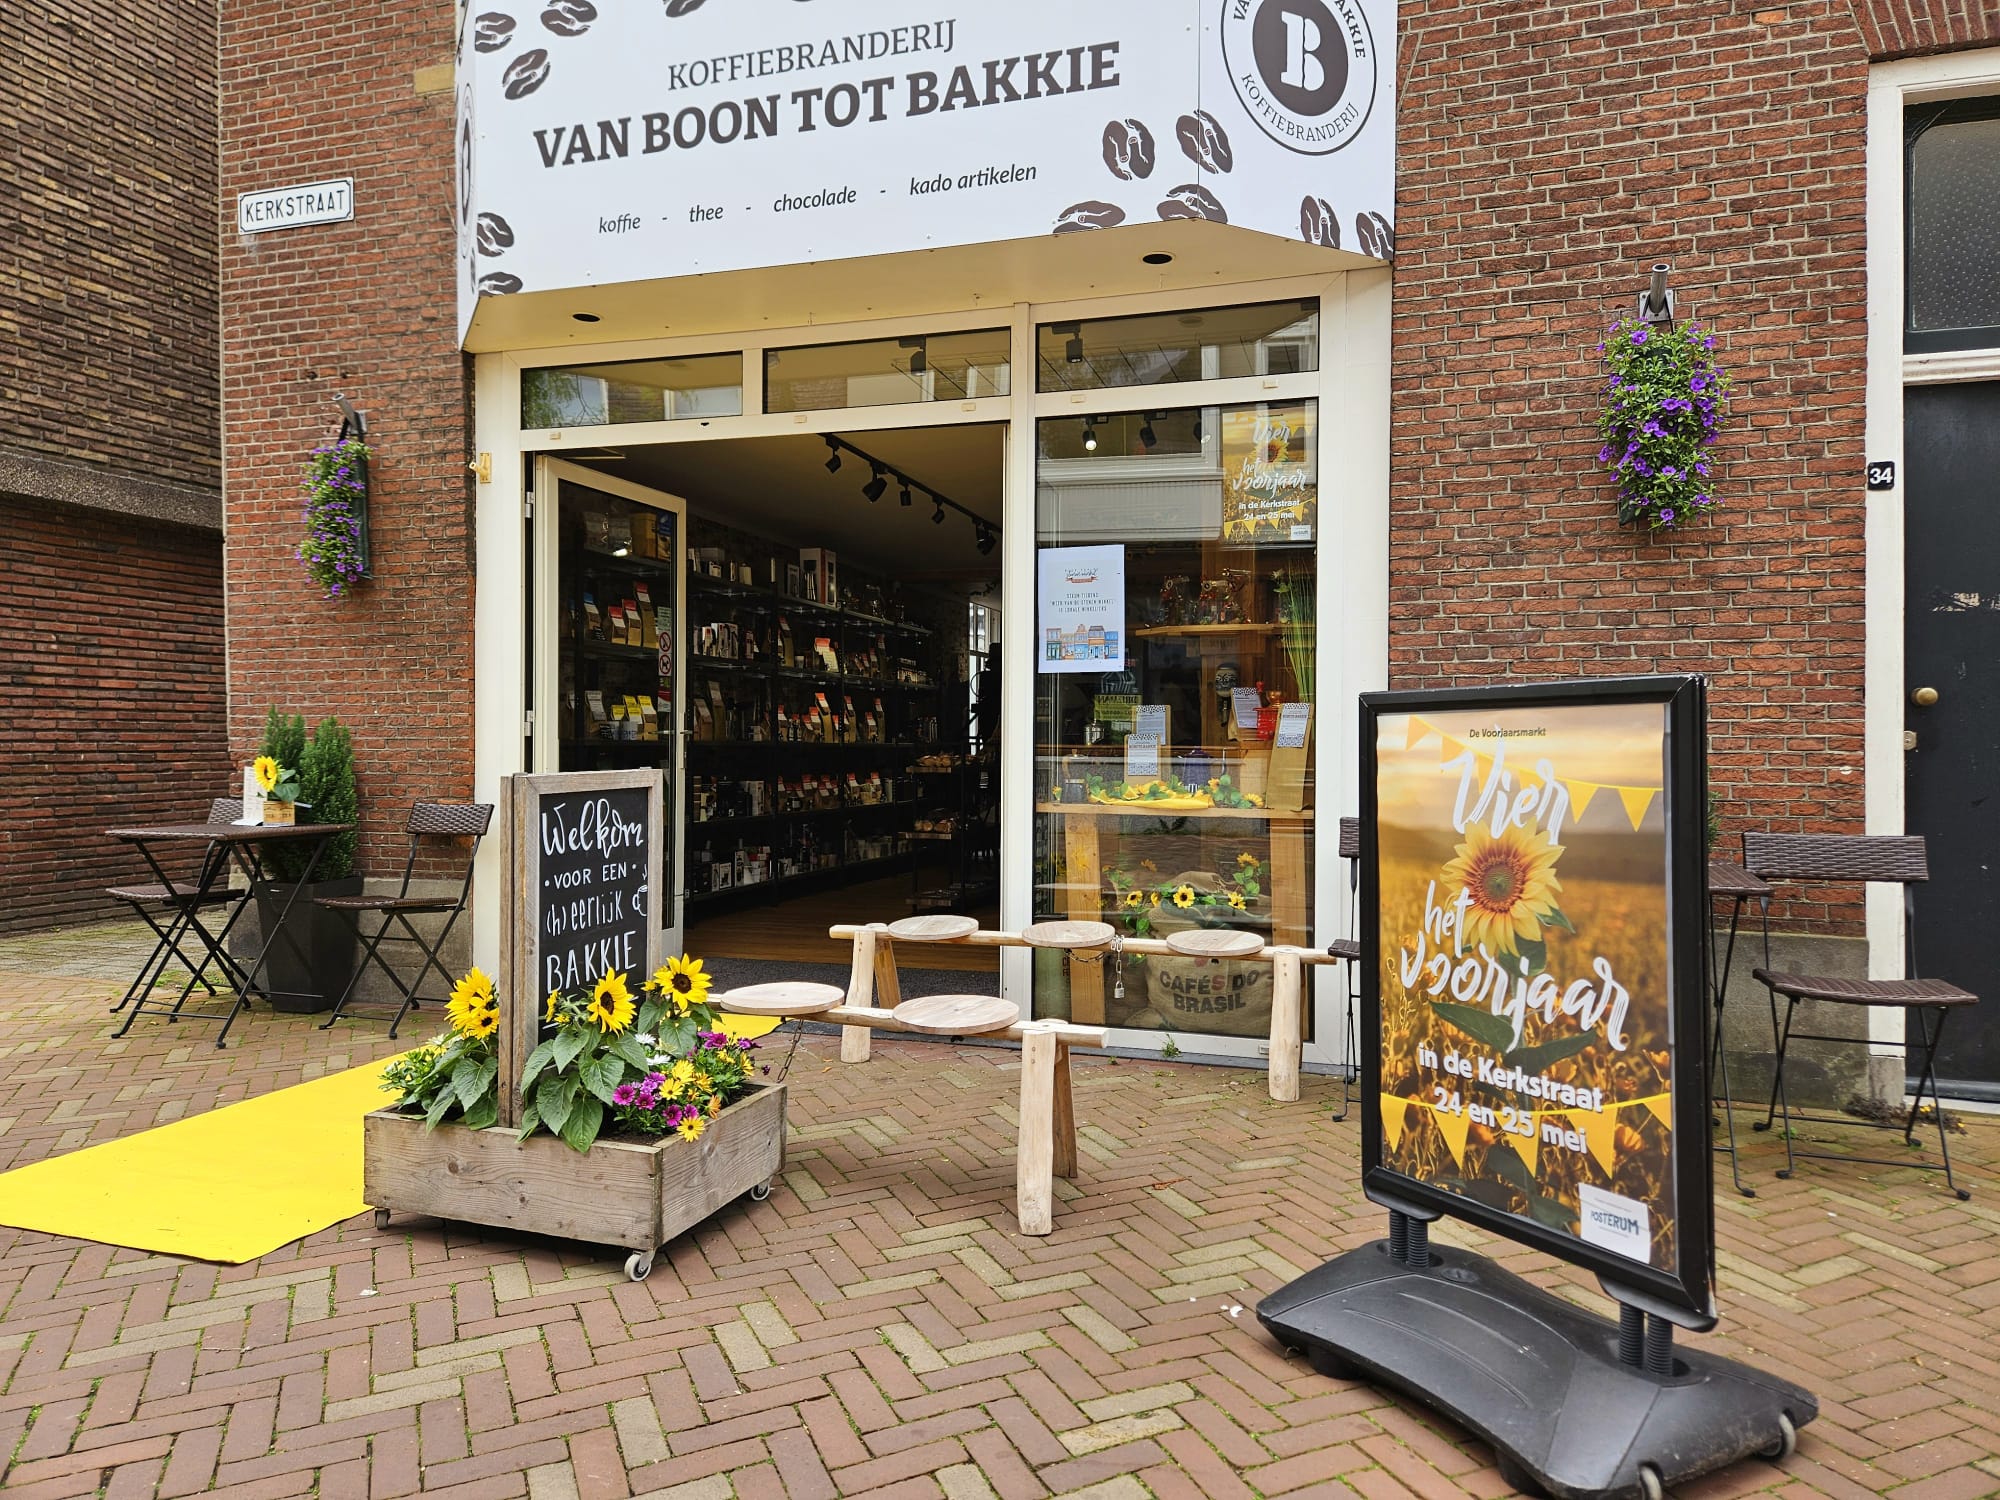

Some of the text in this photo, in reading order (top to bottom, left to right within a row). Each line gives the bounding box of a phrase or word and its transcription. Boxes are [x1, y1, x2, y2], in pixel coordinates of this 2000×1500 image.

[1233, 0, 1250, 20] VA
[1334, 0, 1366, 58] AKKIE
[667, 19, 957, 91] KOFFIEBRANDERIJ
[1281, 11, 1325, 91] B
[532, 41, 1120, 168] VAN BOON TOT BAKKIE
[1241, 73, 1359, 142] KOFFIEBRANDERIJ
[245, 190, 345, 223] KERKSTRAAT
[598, 213, 641, 234] koffie
[689, 205, 724, 224] thee
[773, 187, 857, 213] chocolade
[909, 175, 953, 196] kado
[957, 164, 1037, 190] artikelen
[1252, 420, 1290, 443] Vier
[1243, 457, 1262, 477] het
[1869, 467, 1893, 484] 34
[1243, 513, 1254, 521] 24
[1268, 511, 1278, 519] 25
[1248, 501, 1259, 509] de
[1260, 499, 1300, 509] Kerkstraat
[1469, 727, 1547, 738] De Voorjaarsmarkt
[1440, 724, 1569, 846] Vier
[542, 798, 644, 859] Welkom
[553, 861, 627, 889] VOOR EEN
[1424, 879, 1475, 958] het
[546, 930, 637, 995] BAKKIE
[1160, 970, 1260, 995] CAFÉS DO
[1173, 993, 1247, 1013] BRASIL
[1418, 1043, 1604, 1114] in de Kerkstraat
[1433, 1087, 1588, 1155] 24 en 25 mei
[1590, 1210, 1639, 1236] POSTERUM
